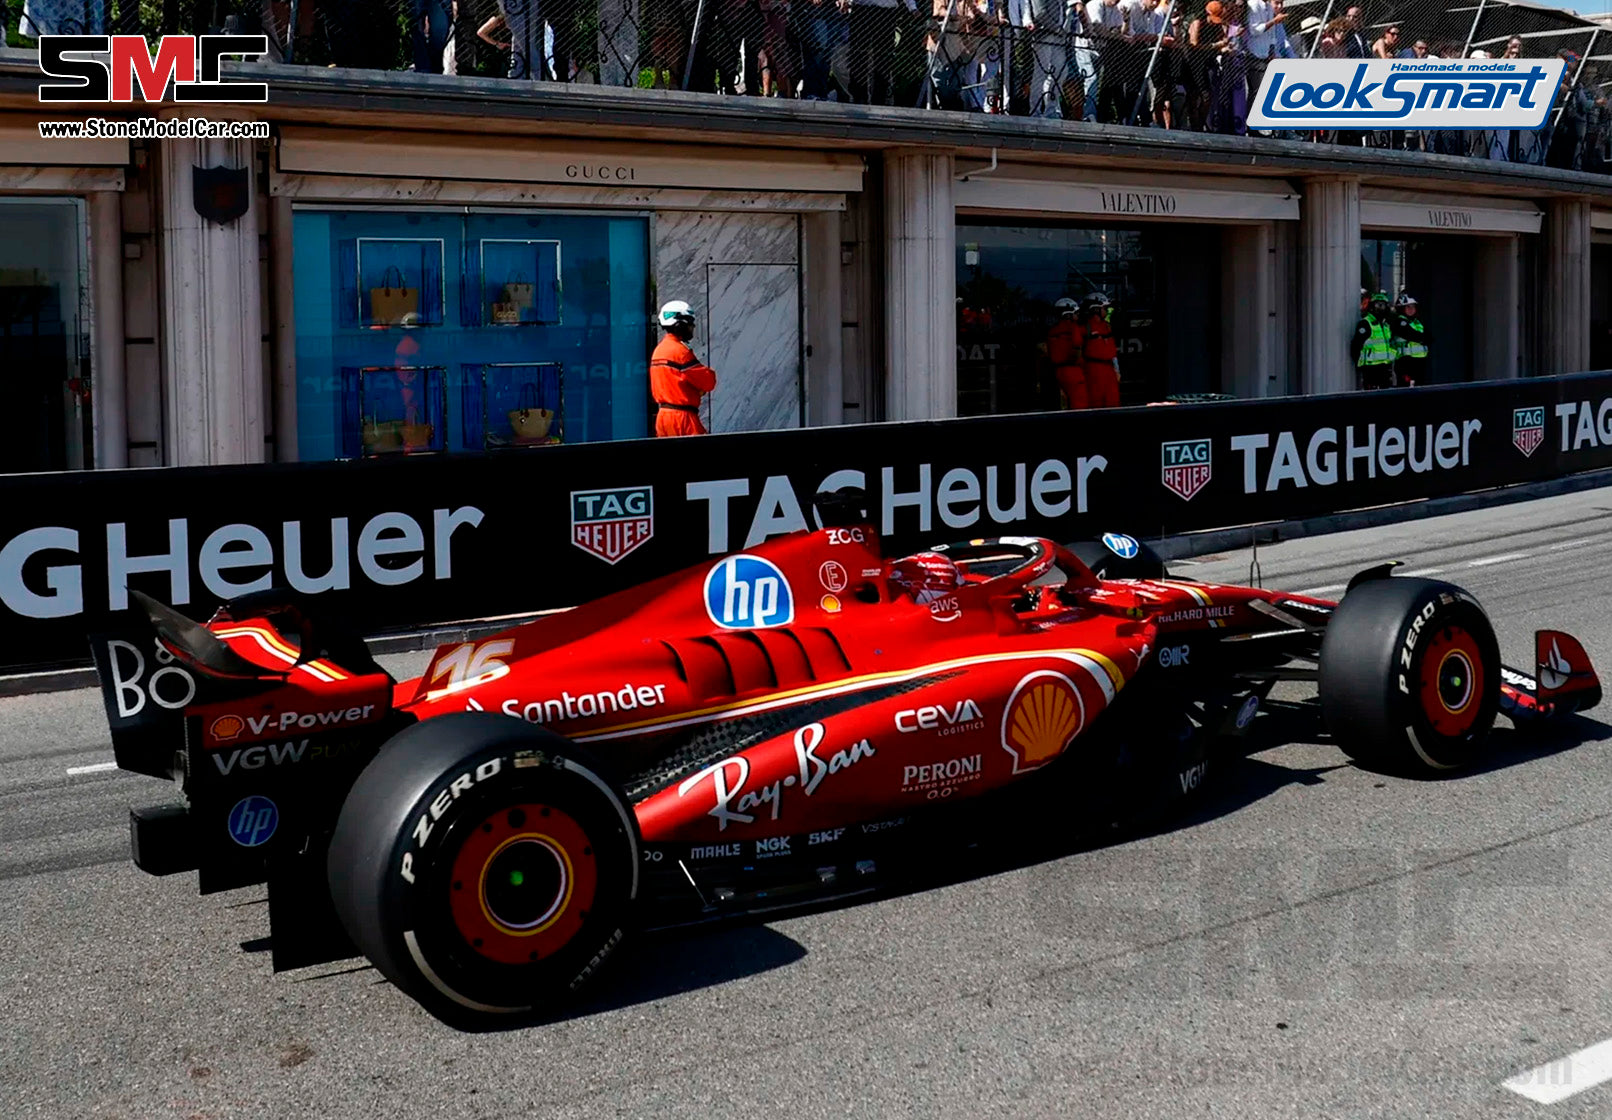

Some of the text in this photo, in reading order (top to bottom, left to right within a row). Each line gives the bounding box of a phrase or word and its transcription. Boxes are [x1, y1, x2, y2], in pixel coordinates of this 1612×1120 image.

[565, 165, 635, 180] GUCCI
[1101, 192, 1176, 213] VALENTINO
[1428, 210, 1472, 228] VALENTINO
[1516, 411, 1542, 427] TAG
[1166, 443, 1208, 464] TAG
[1165, 466, 1209, 496] HEUER
[578, 492, 646, 518] TAG
[576, 520, 649, 559] HEUER
[722, 556, 779, 628] hp
[930, 597, 959, 614] aws
[1206, 605, 1235, 618] MILLE
[1401, 601, 1435, 669] ZERO
[425, 639, 516, 702] 16
[502, 684, 666, 724] Santander
[247, 703, 375, 735] V-Power
[937, 721, 985, 737] LOGISTICS
[212, 739, 310, 776] VGW
[903, 754, 982, 786] PERONI
[412, 757, 501, 848] ZERO
[234, 797, 274, 847] hp
[756, 836, 791, 853] NGK
[808, 828, 846, 845] SKF
[691, 844, 741, 859] MAHLE
